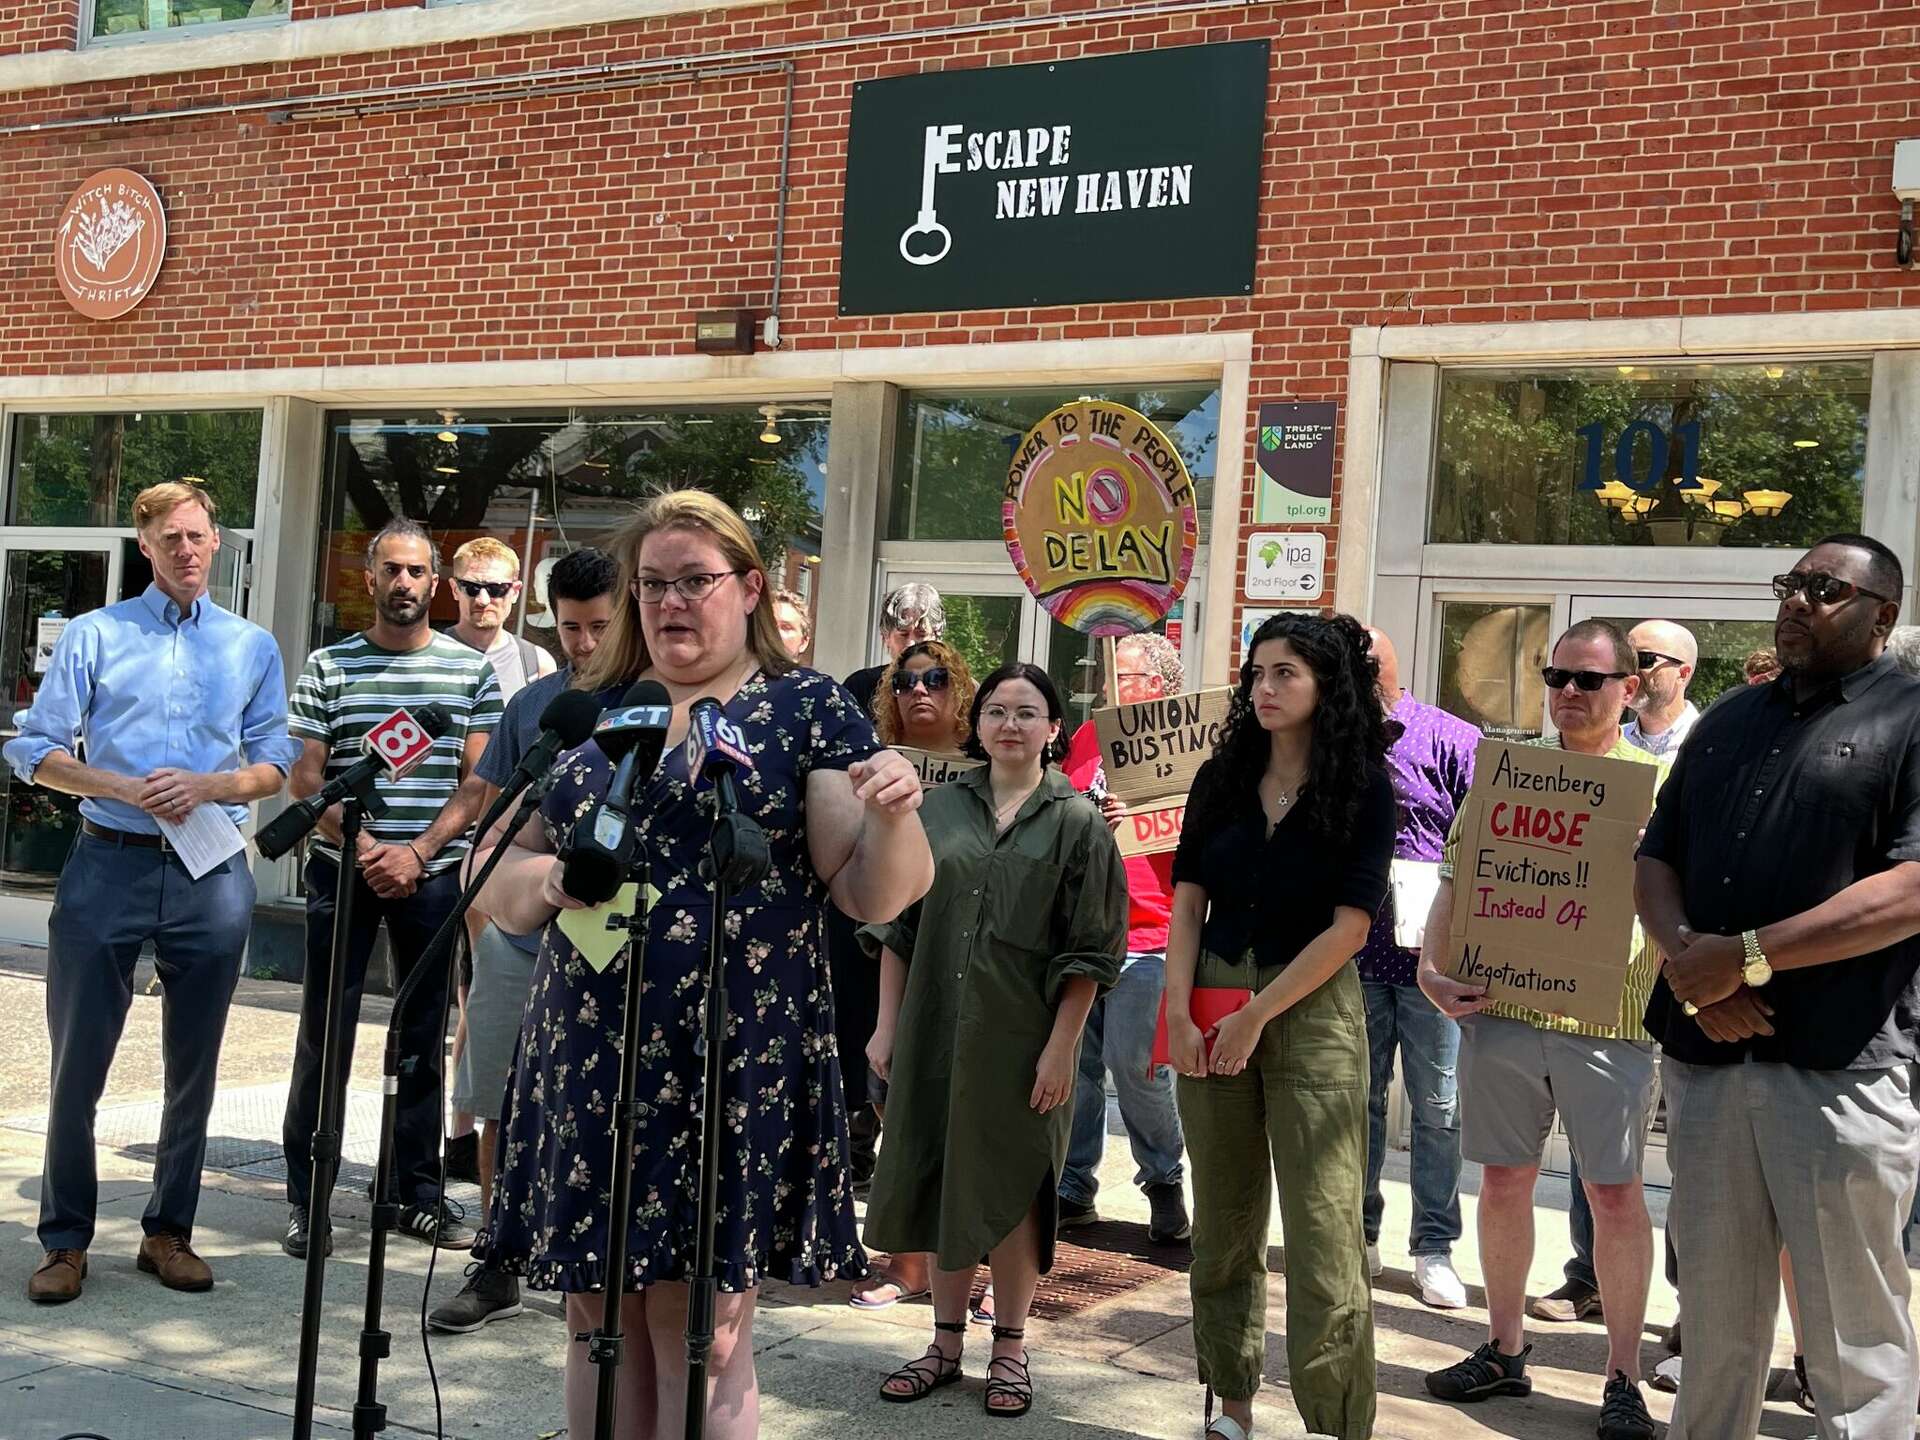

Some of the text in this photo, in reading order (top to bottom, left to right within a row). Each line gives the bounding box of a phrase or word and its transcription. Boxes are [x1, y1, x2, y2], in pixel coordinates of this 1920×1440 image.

[937, 124, 1072, 173] ESCAPE
[994, 164, 1194, 221] NEW HAVEN
[1284, 433, 1323, 441] PUBLIC
[1285, 424, 1320, 433] TRUST
[1005, 431, 1048, 502] POWER
[1051, 412, 1079, 436] TO
[1089, 409, 1127, 440] THE
[1132, 426, 1192, 507] PEOPLE
[1576, 419, 1705, 492] 101
[1054, 467, 1131, 527] NO
[1287, 504, 1326, 517] tpl.org
[1043, 520, 1174, 585] DELAY
[1286, 543, 1311, 566] ipa
[1252, 577, 1297, 588] 2nd Floor
[621, 706, 669, 725] CT
[715, 716, 748, 753] 61
[1117, 694, 1201, 737] UNION
[378, 720, 421, 758] 8
[899, 751, 966, 784] olida
[1155, 763, 1174, 778] is
[1492, 749, 1606, 807] Aizenberg
[1490, 802, 1591, 846] CHOSE
[1474, 888, 1588, 931] Instead Of
[1458, 944, 1577, 993] Negotiations
